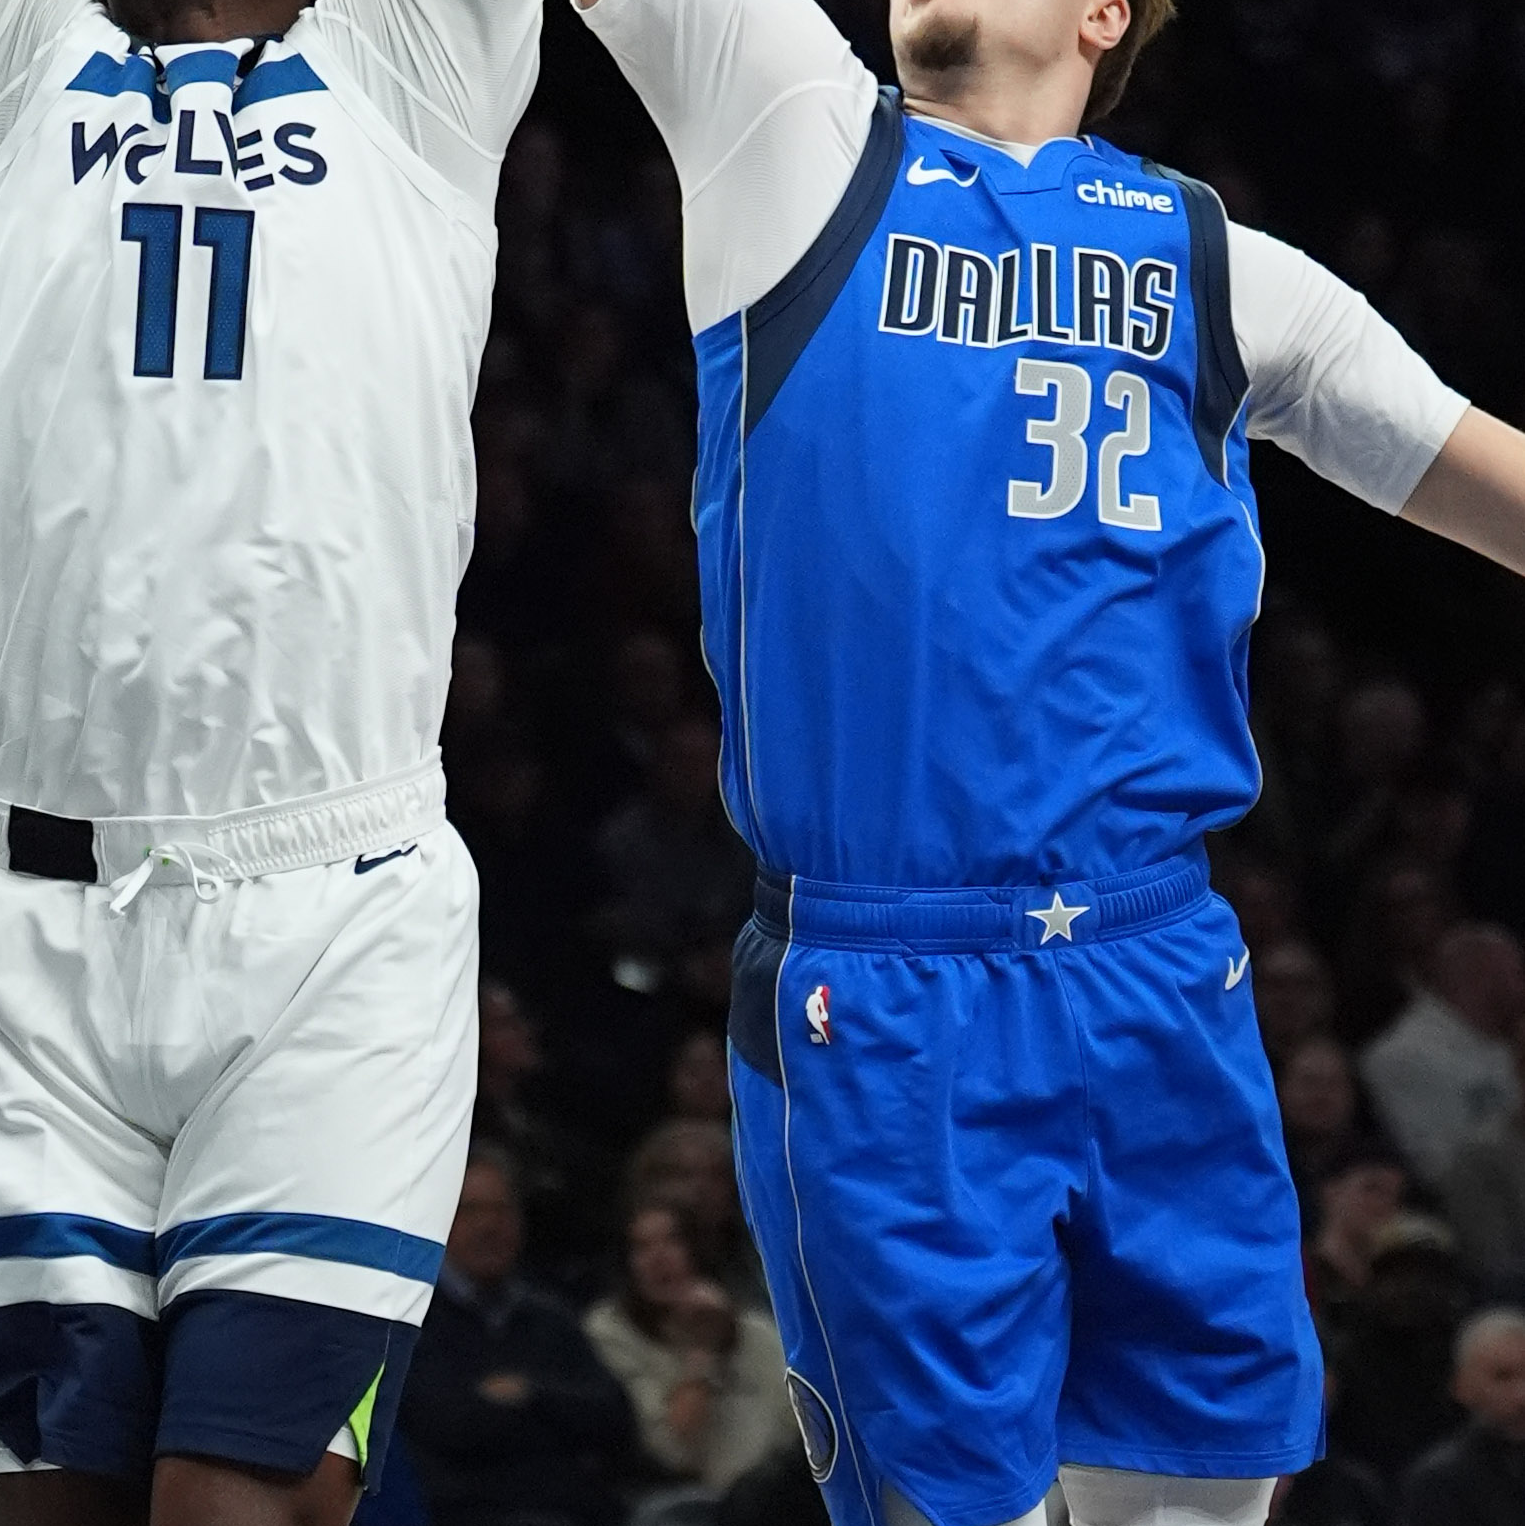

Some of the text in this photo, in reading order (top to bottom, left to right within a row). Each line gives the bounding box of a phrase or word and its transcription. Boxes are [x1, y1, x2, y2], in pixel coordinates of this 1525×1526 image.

[1076, 178, 1175, 214] chime
[120, 202, 256, 381] 11
[878, 232, 1178, 362] DALLAS
[1007, 357, 1163, 532] 32
